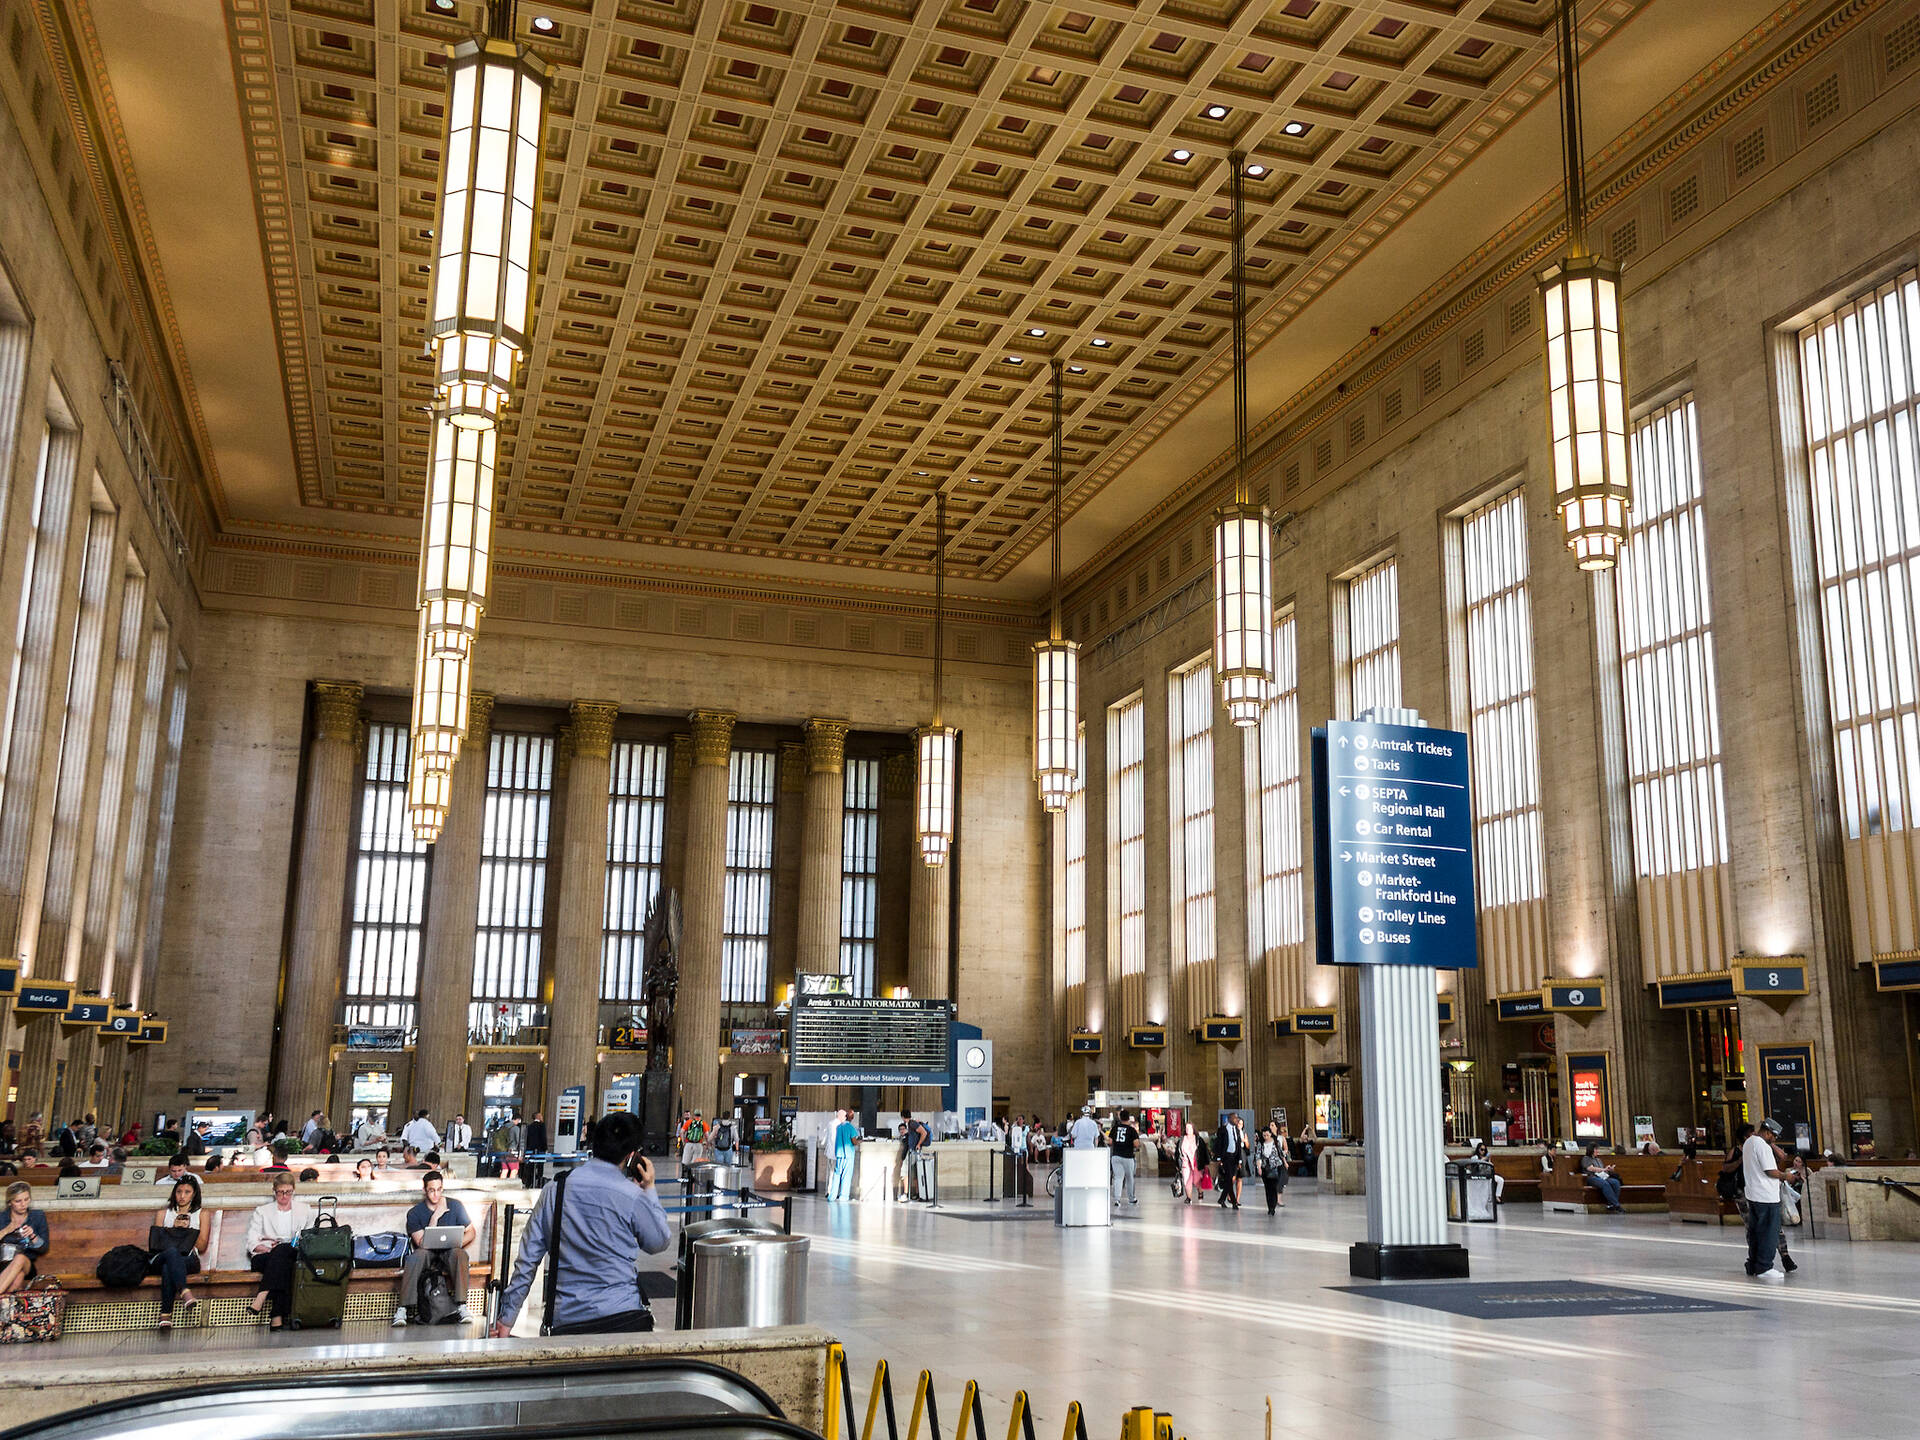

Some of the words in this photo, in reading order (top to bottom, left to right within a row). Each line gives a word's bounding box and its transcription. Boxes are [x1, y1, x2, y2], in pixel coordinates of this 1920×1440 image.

[1371, 738, 1414, 752] Amtrak
[1416, 742, 1452, 757] Tickets
[1371, 758, 1400, 772] Taxis
[1372, 788, 1408, 800] SEPTA
[1372, 802, 1422, 816] Regional
[1426, 806, 1445, 818] Rail
[1373, 822, 1393, 834] Car
[1396, 824, 1432, 838] Rental
[1356, 852, 1399, 865] Market
[1402, 854, 1436, 868] Street
[1376, 874, 1421, 887] Market-
[1376, 888, 1431, 903] Frankford
[1434, 891, 1456, 904] Line
[1376, 910, 1416, 926] Trolley
[1418, 912, 1446, 924] Lines
[1377, 931, 1411, 944] Buses
[1768, 972, 1778, 986] 8
[44, 995, 57, 1003] Cap
[808, 998, 832, 1006] Amtrak
[863, 1000, 920, 1008] INFORMATION
[82, 1008, 90, 1018] 3
[144, 1029, 150, 1038] 1
[616, 1027, 634, 1042] 21
[1220, 1026, 1227, 1035] 4
[1776, 1063, 1790, 1071] Gate
[1116, 1130, 1126, 1142] 15
